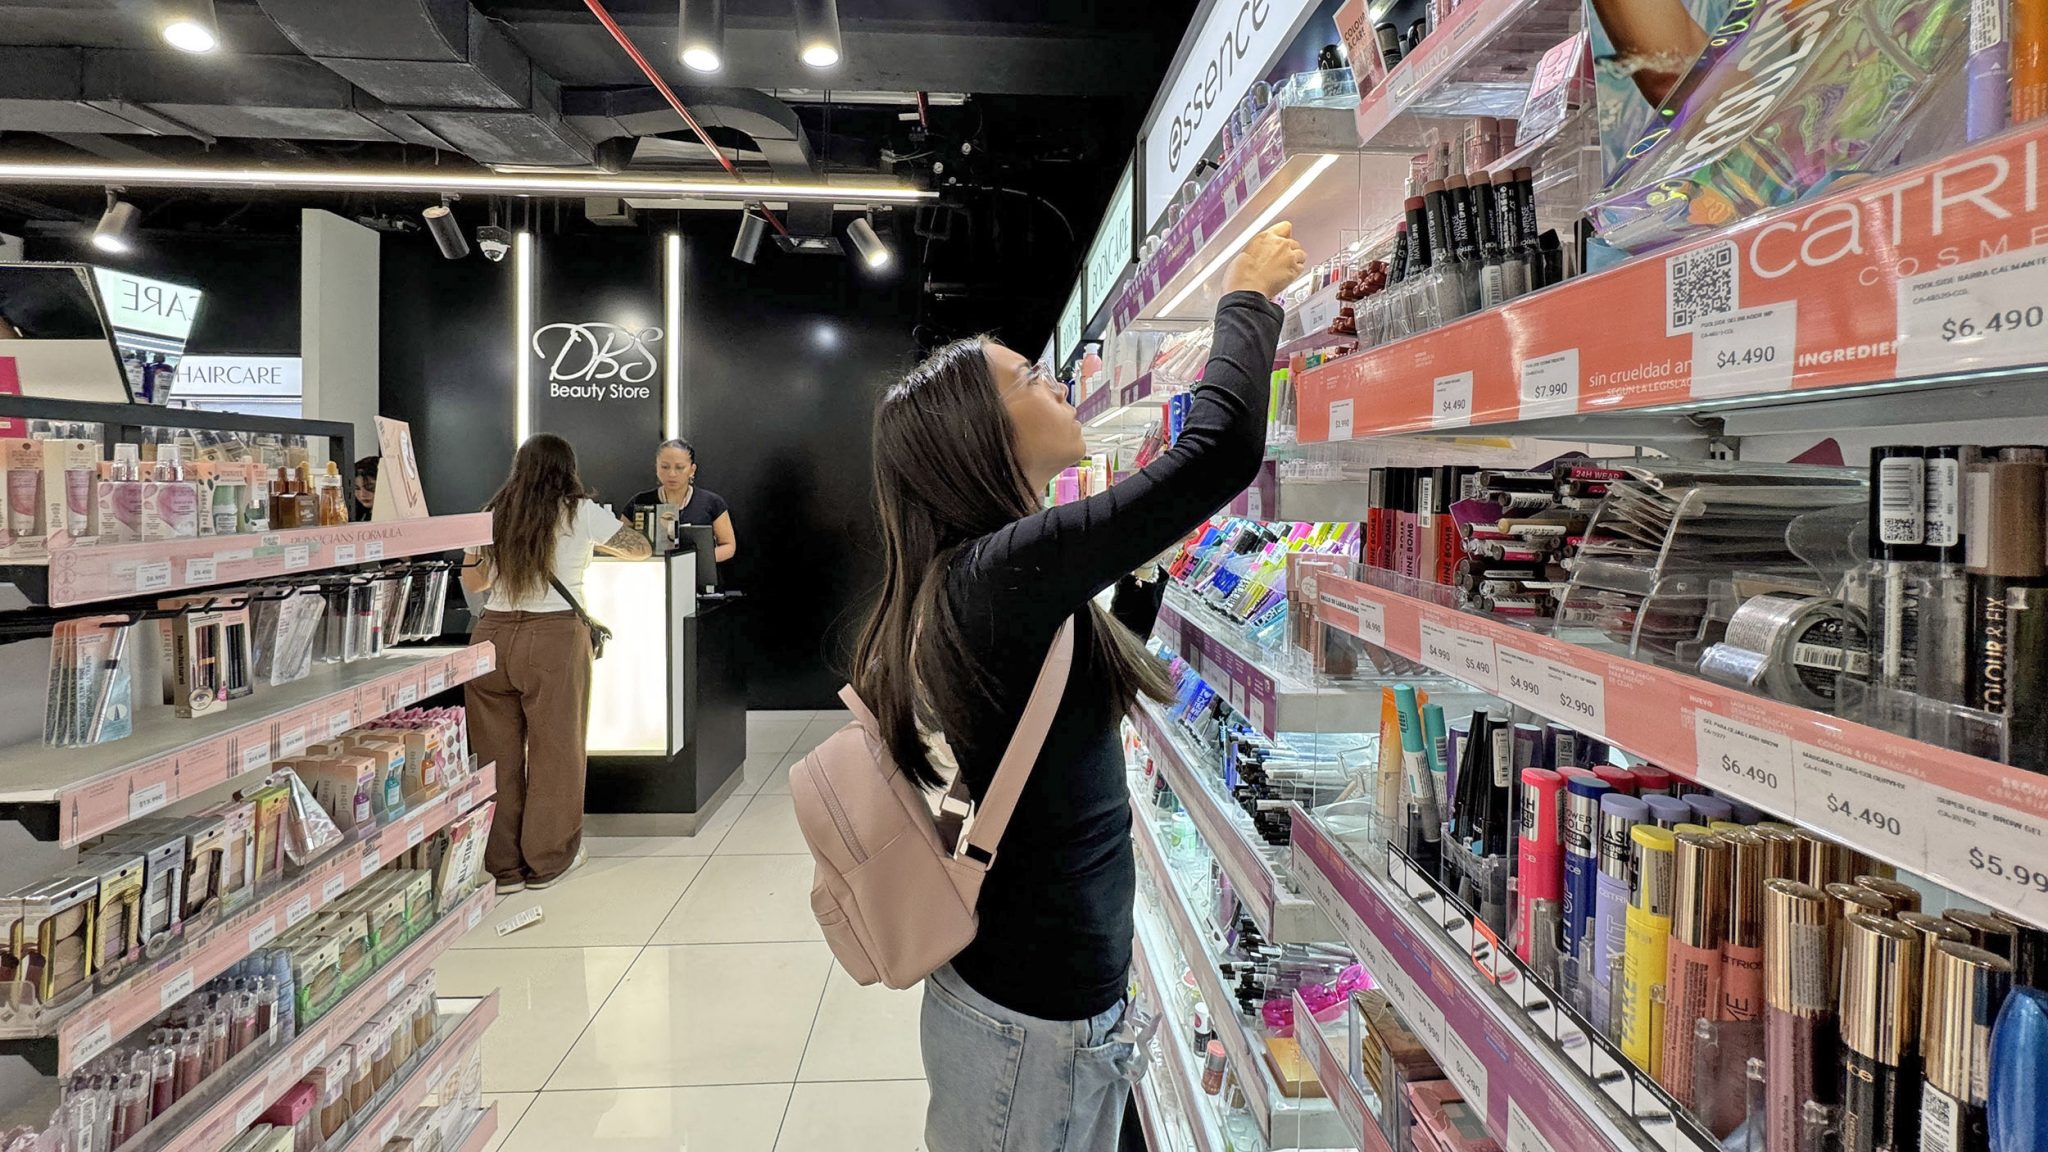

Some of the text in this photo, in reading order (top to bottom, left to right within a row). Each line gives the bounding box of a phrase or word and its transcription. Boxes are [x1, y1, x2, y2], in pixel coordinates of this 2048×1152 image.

[1344, 12, 1366, 41] COLOUR
[1704, 241, 1728, 254] MARCA
[1941, 305, 2044, 342] $6.490
[532, 322, 665, 383] DBS
[1717, 346, 1775, 369] $4.490
[177, 365, 283, 385] HAIRCARE
[1589, 370, 1607, 388] sin
[1610, 358, 1671, 384] crueldad
[551, 383, 650, 401] Beauty Store
[1534, 382, 1568, 399] $7.990
[1443, 399, 1466, 412] $4.490
[1576, 470, 1592, 479] 24H
[357, 527, 403, 542] FORMULA
[1986, 597, 2005, 621] FIX
[1429, 644, 1451, 662] $4.990
[1465, 657, 1490, 675] $5.490
[1510, 675, 1540, 696] $4.990
[1559, 692, 1595, 718] $2.990
[1722, 754, 1778, 789] $6.490
[1826, 792, 1901, 836] $4.490
[1456, 1060, 1481, 1098] $6.290
